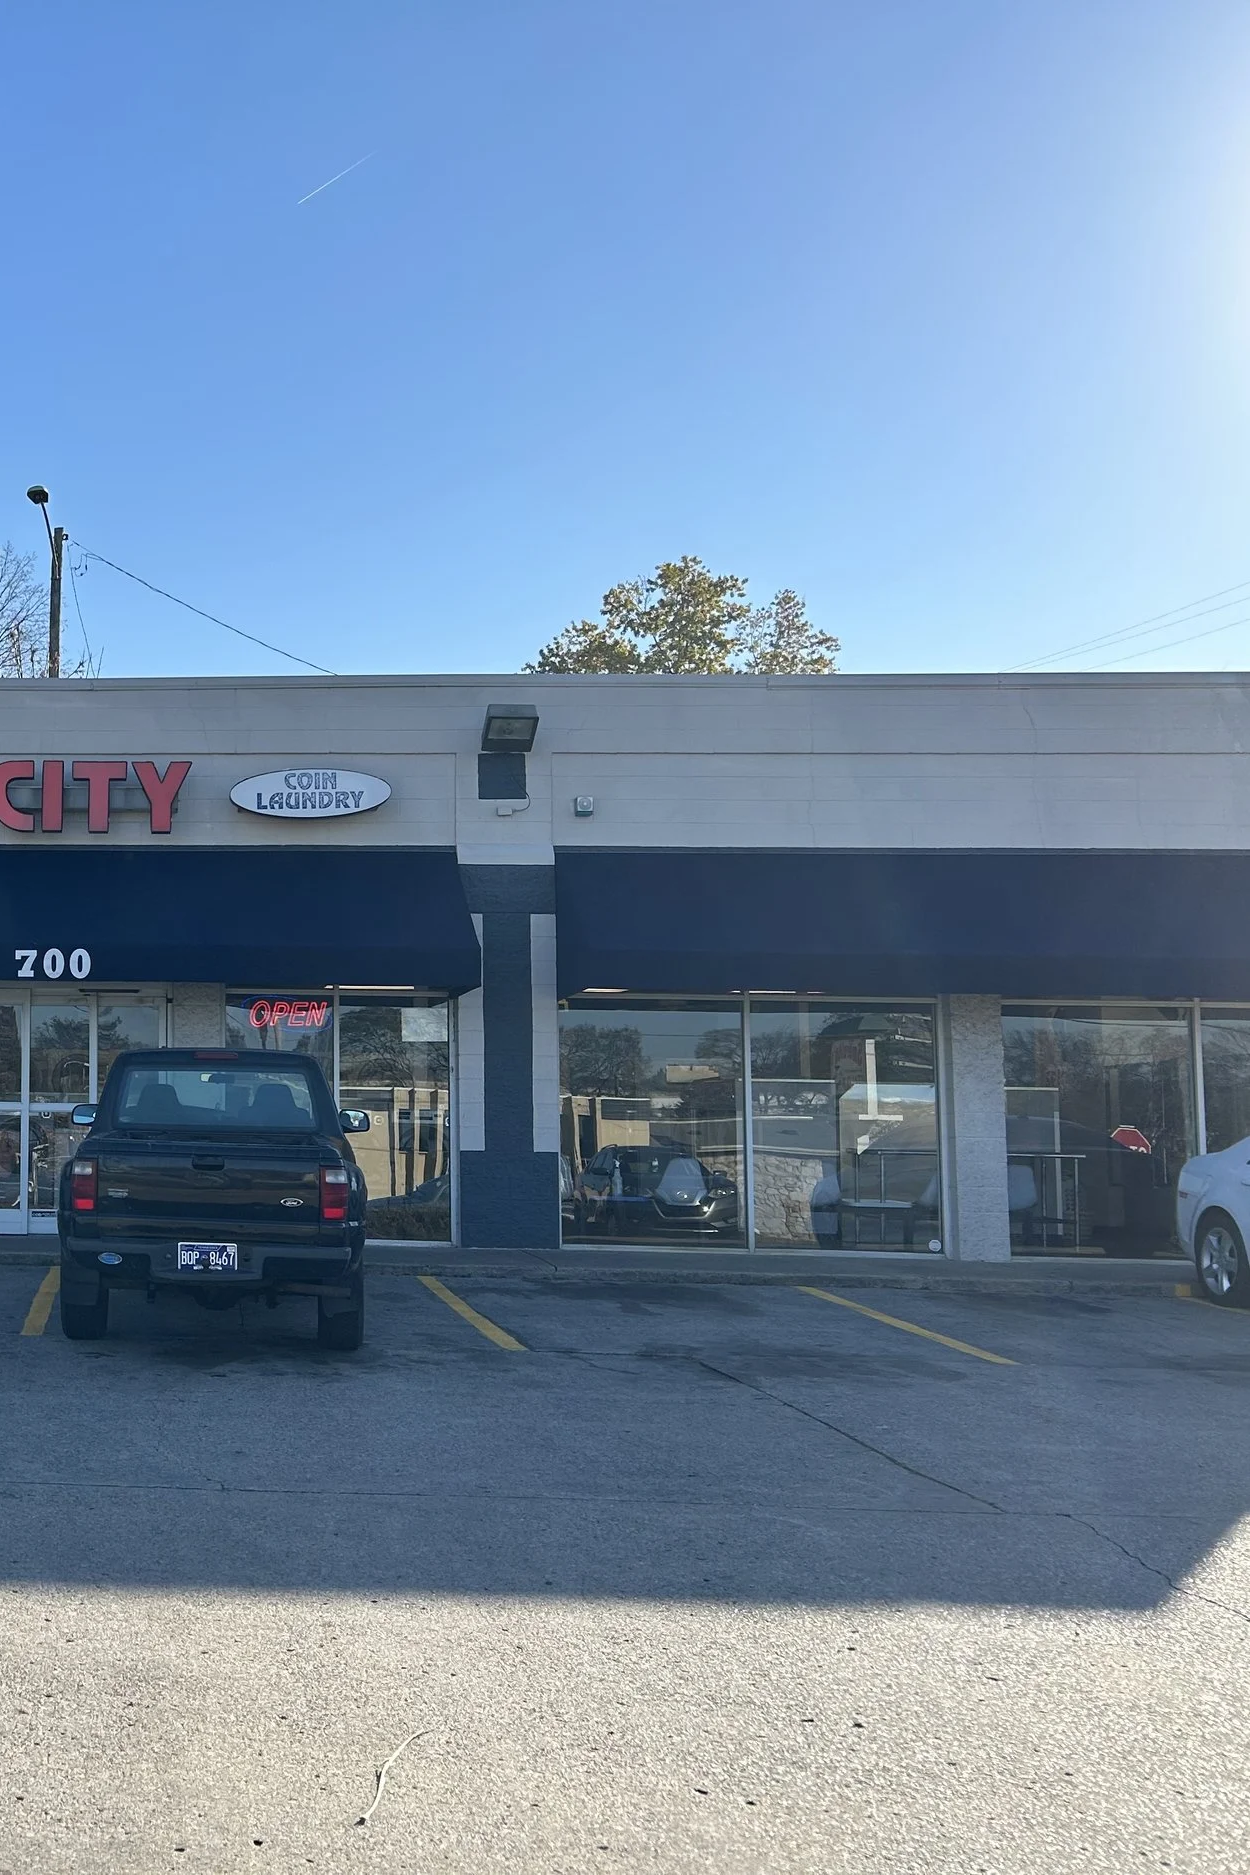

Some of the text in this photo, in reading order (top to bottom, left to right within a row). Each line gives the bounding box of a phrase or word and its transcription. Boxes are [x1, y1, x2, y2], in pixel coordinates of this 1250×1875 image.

[284, 772, 337, 790] COIN
[256, 791, 364, 810] LAUNDRY
[15, 948, 91, 979] 700
[249, 1000, 327, 1028] OPEN
[210, 1251, 235, 1266] 8467
